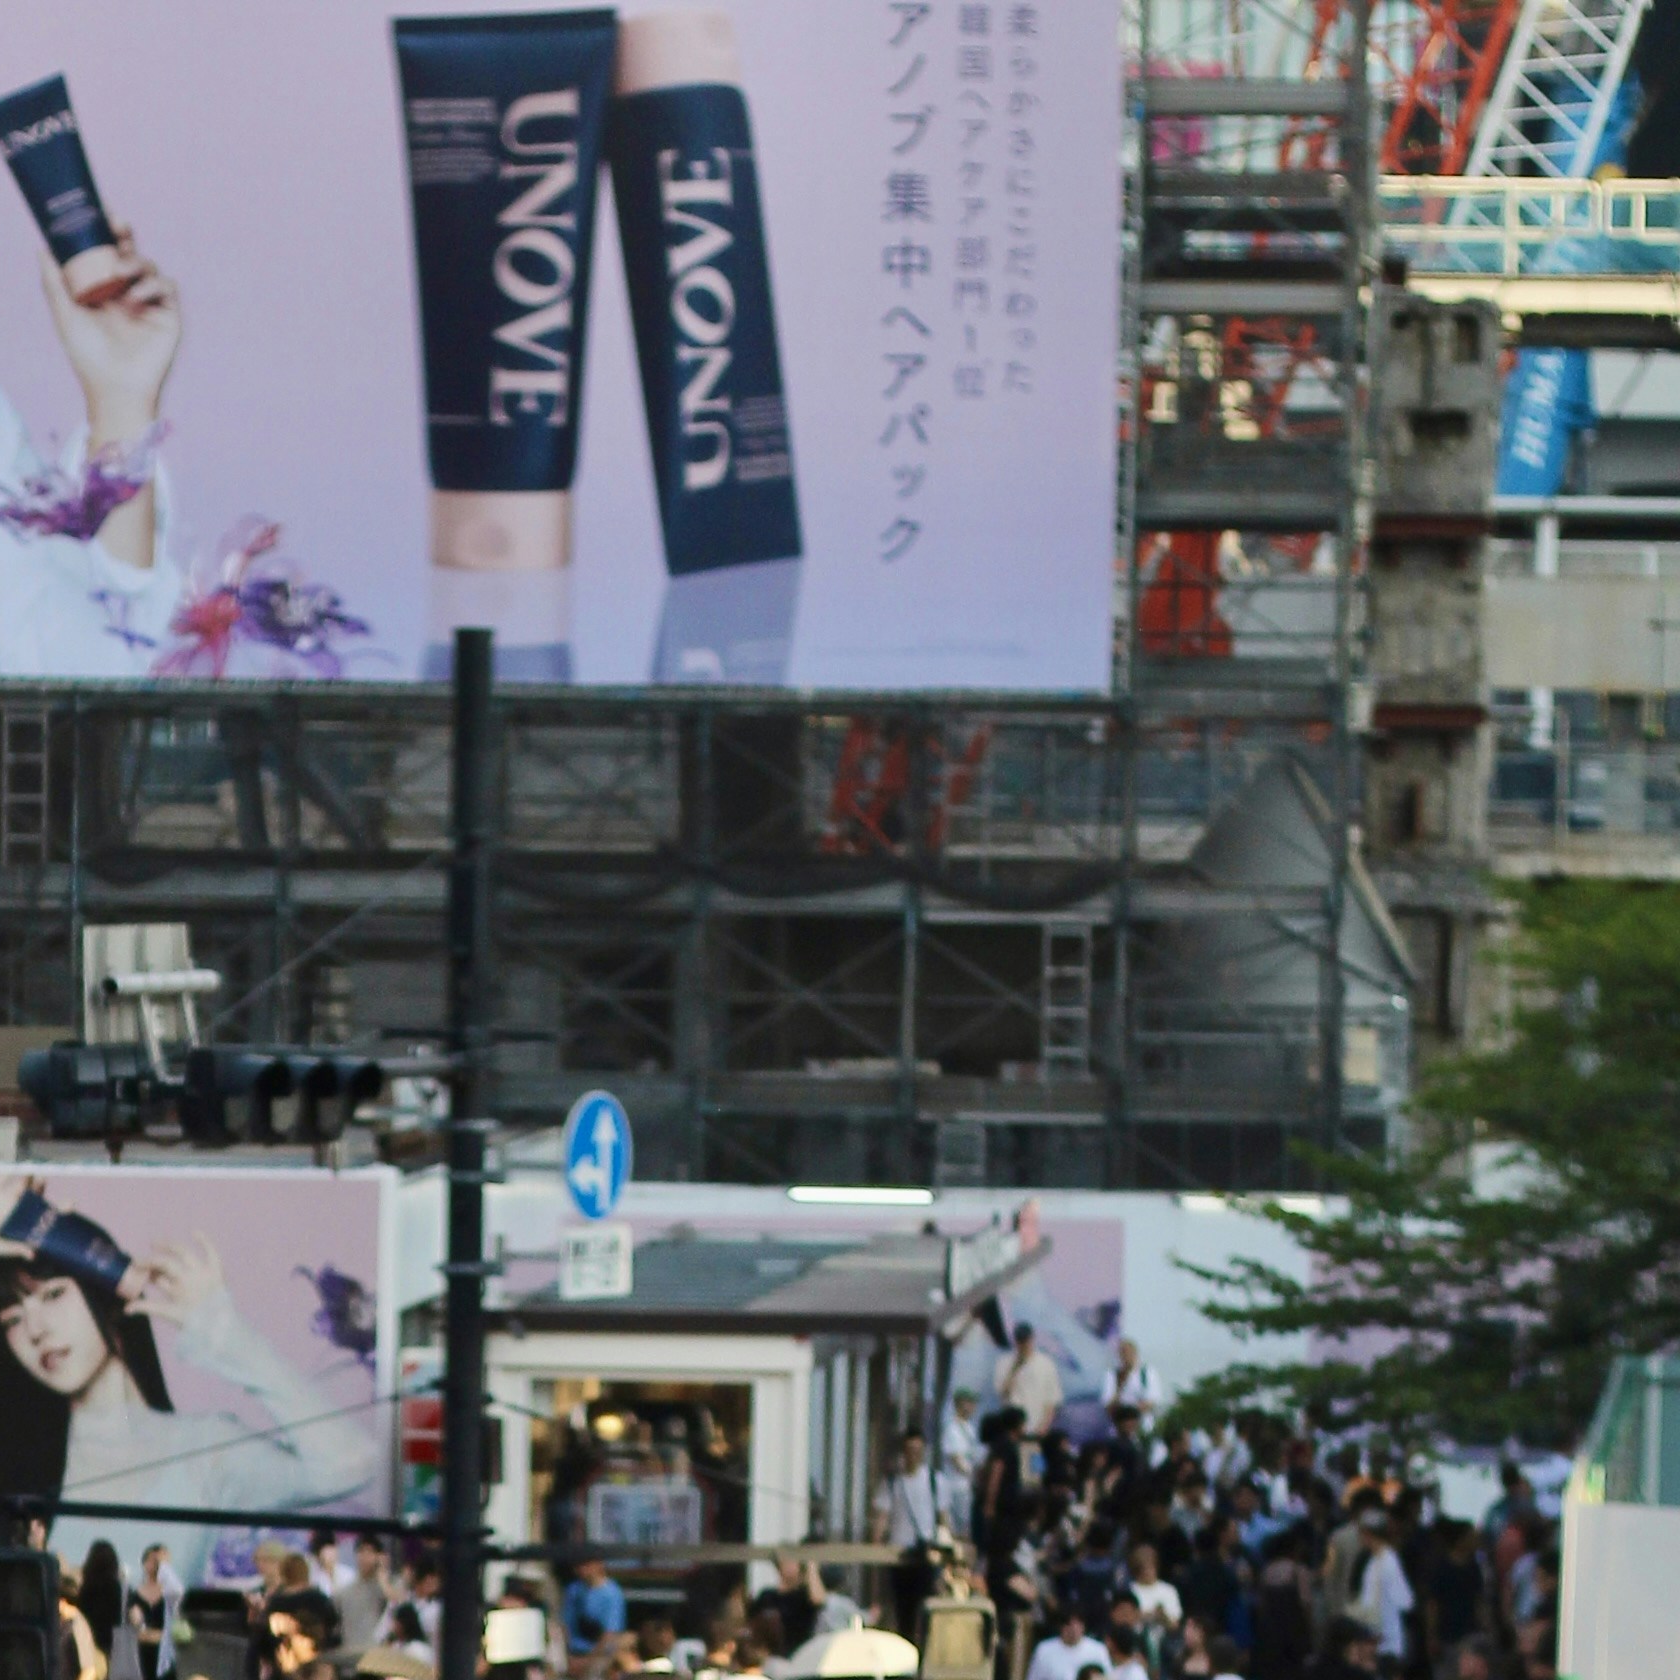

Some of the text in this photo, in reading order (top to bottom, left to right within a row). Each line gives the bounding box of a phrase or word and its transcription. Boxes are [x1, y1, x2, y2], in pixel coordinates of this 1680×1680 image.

[489, 90, 581, 428] UNOVE
[657, 147, 736, 491] UNOVE
[879, 2, 936, 563] アノブ集中ヘアパック
